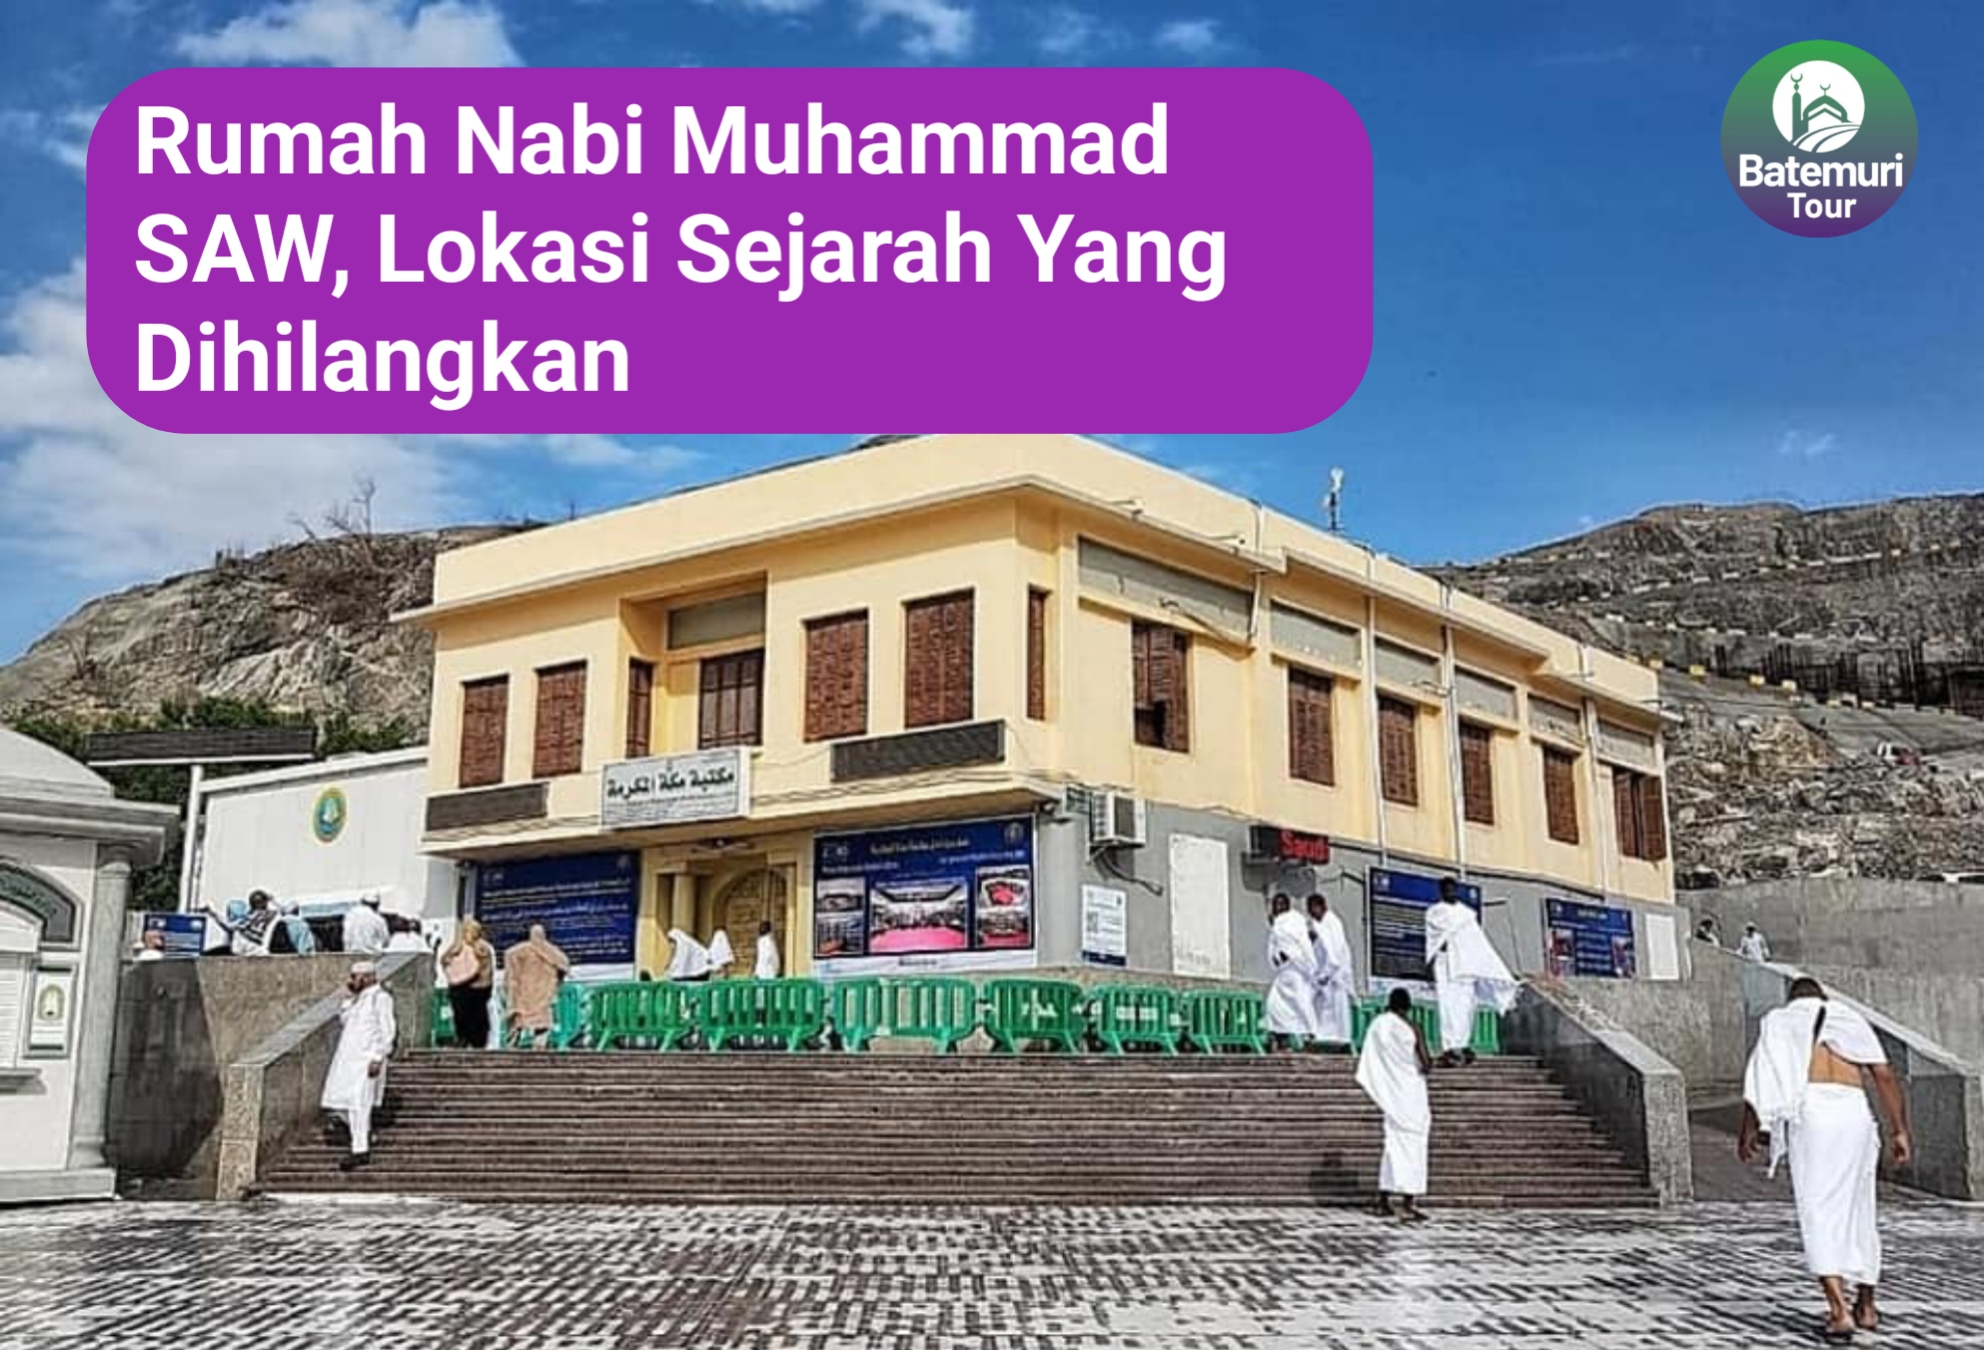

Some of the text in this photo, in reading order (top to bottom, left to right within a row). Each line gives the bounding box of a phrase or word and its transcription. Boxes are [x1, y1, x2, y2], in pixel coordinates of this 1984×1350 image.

[607, 767, 734, 800] مكتبة مكة المكرمة
